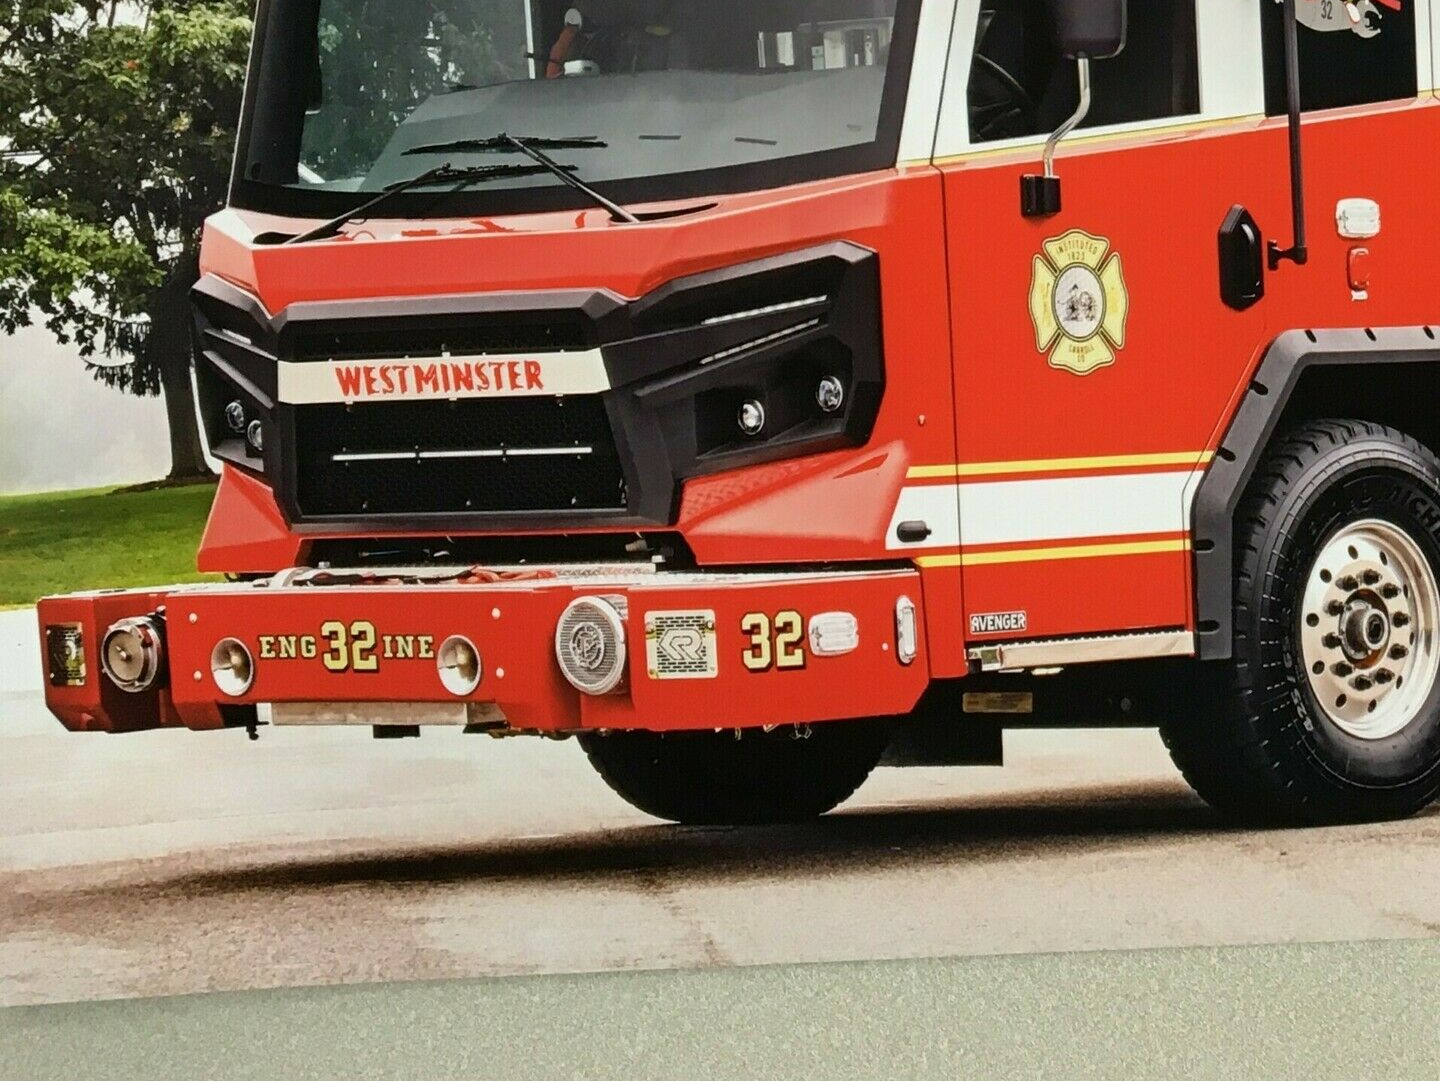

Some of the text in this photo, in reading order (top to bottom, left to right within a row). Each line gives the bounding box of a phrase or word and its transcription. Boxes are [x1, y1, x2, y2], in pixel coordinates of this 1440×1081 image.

[1320, 0, 1333, 20] 32
[335, 360, 544, 397] WESTMINSTER
[740, 609, 806, 672] 32
[971, 613, 1026, 632] AVENGER
[258, 620, 435, 673] ENG 32 INE
